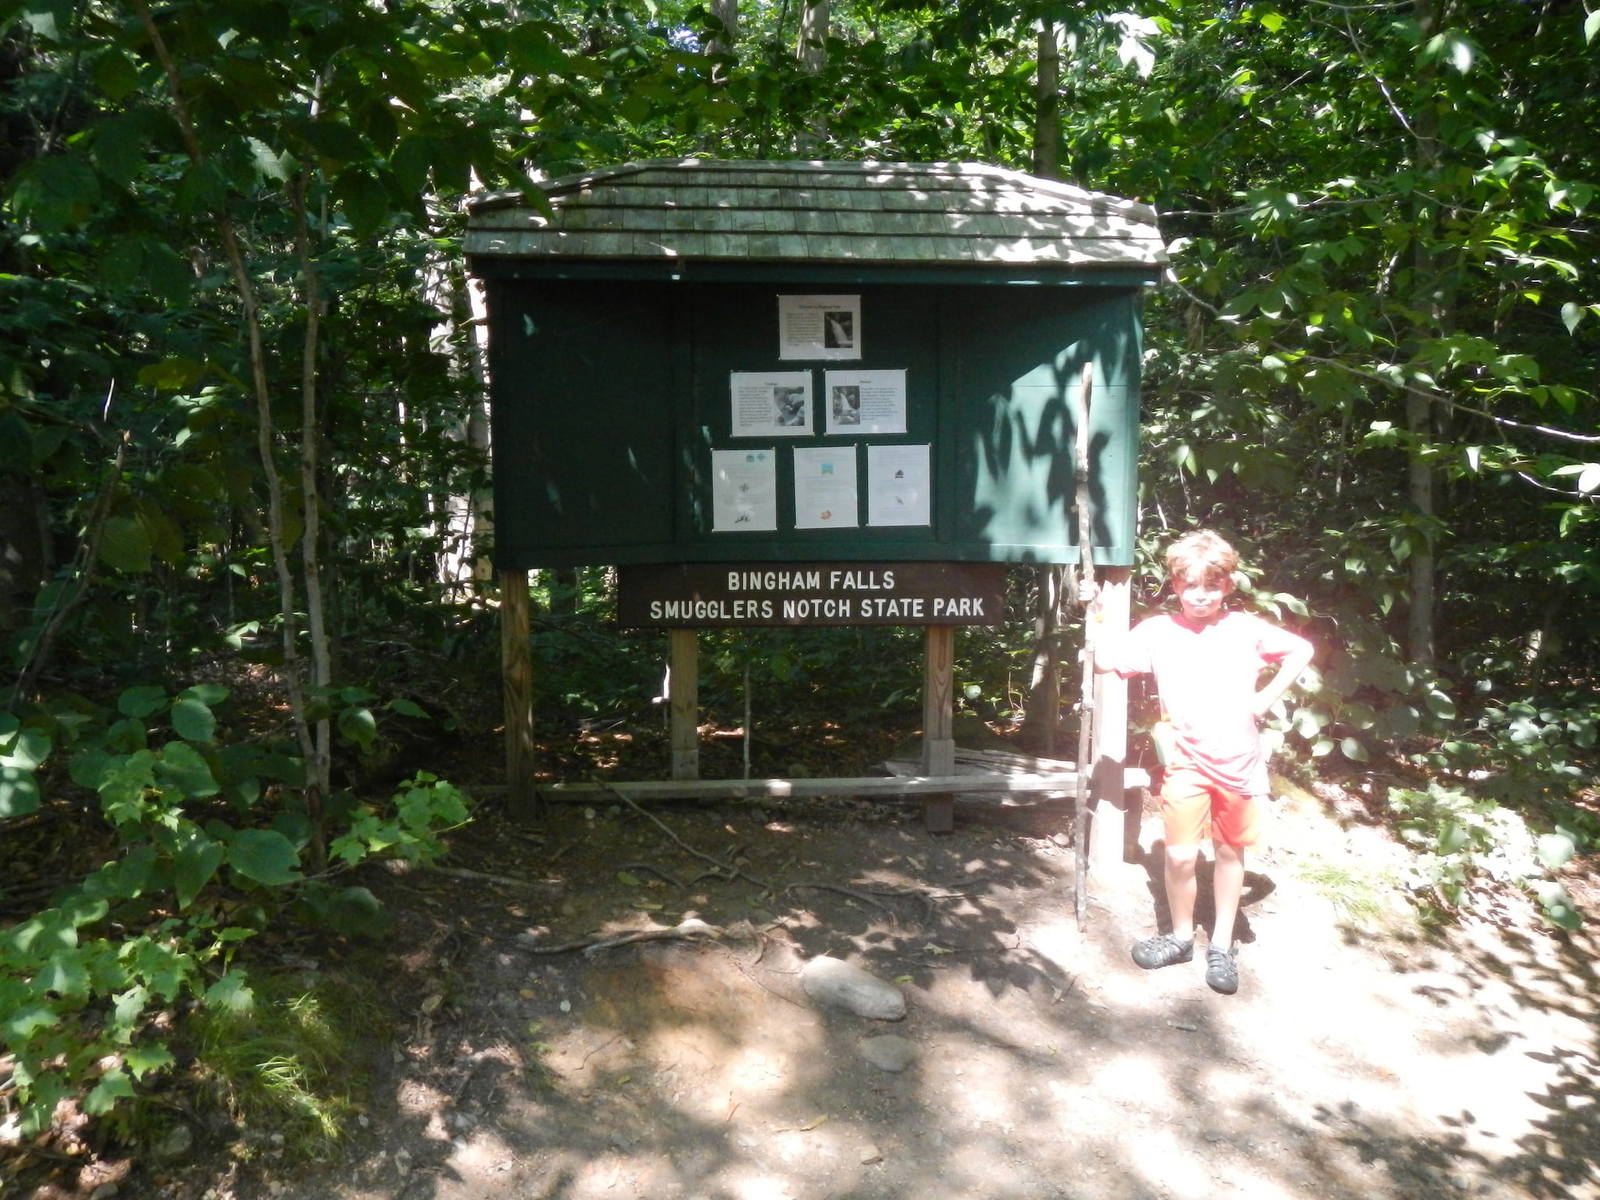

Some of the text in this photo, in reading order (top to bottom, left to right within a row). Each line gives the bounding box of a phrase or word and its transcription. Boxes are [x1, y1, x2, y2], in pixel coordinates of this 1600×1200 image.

[728, 570, 895, 590] BINGHAM FALLS
[650, 597, 985, 619] SMUGGLERS NOTCH STATE PARK
